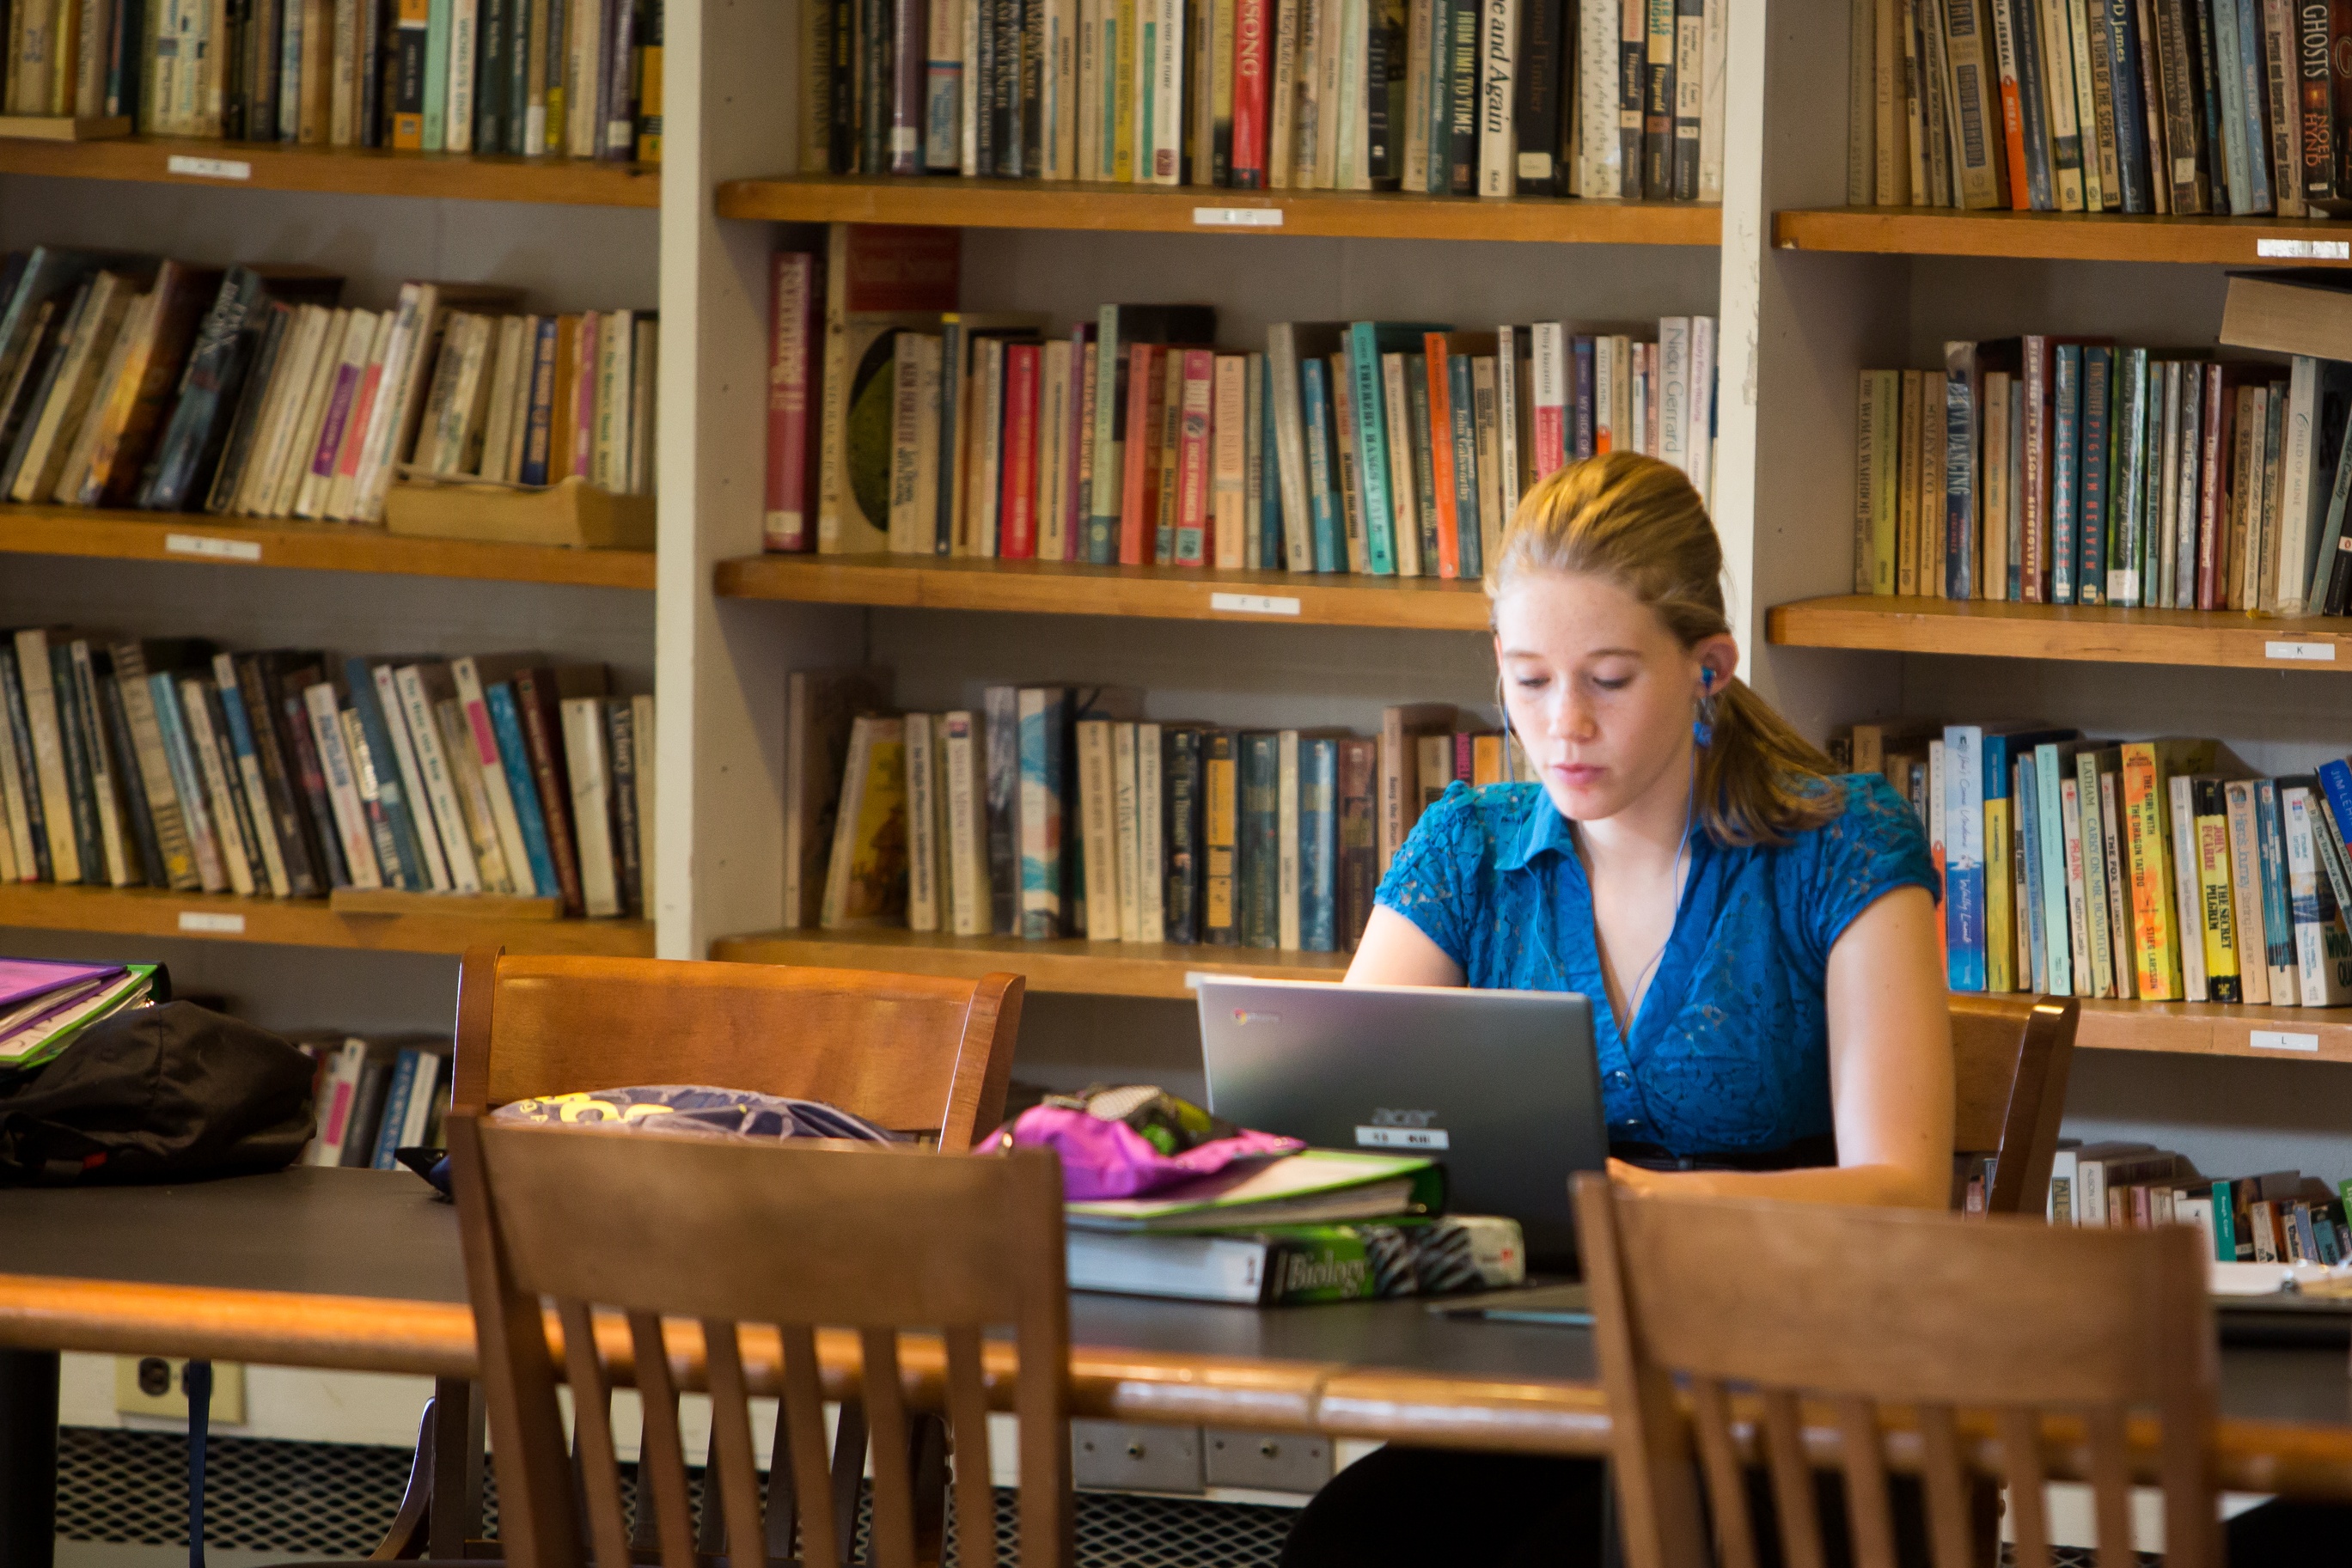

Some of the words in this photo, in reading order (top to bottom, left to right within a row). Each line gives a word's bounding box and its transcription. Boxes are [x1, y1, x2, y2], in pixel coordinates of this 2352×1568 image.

[1276, 7, 1295, 34] Hog
[1457, 10, 1476, 43] FROM
[2091, 15, 2107, 35] THE
[1491, 18, 1511, 64] and
[1998, 21, 2011, 68] JEBREAL
[2093, 39, 2110, 68] TURN
[2110, 19, 2129, 63] James
[2301, 3, 2330, 78] GHOSTS
[1280, 37, 1295, 83] Butcher
[1455, 46, 1475, 74] TIME
[1627, 53, 1640, 98] Fitzgerald
[2096, 70, 2111, 83] OF
[1455, 76, 1474, 95] TO
[1530, 51, 1549, 113] Timber
[1653, 67, 1665, 113] Fitzgerald
[2098, 86, 2111, 108] THE
[1453, 97, 1474, 135] TIME
[1486, 66, 1511, 134] Again
[1963, 111, 1986, 167] MAHFOUZ
[2099, 110, 2114, 149] SCREW
[2304, 112, 2318, 168] HYND
[2316, 113, 2331, 165] NOEL
[1665, 327, 1685, 375] Nicci
[2028, 342, 2039, 374] HIGH
[1863, 377, 1873, 399] THE
[2028, 378, 2039, 408] TIDE
[2058, 359, 2076, 416] KINGSOLVER
[2087, 361, 2105, 418] KINGSOLVER
[2123, 355, 2135, 398] Barbara
[1579, 394, 1589, 411] MY
[1664, 380, 1683, 454] Gerrard
[1456, 408, 1469, 436] John
[1579, 412, 1589, 437] SIDE
[1859, 401, 1872, 452] WOMAN
[2027, 412, 2038, 428] IN
[2120, 400, 2134, 458] Kingsolver
[2294, 412, 2310, 460] CHILD
[1187, 442, 1200, 471] DICK
[1579, 439, 1589, 452] OF
[2026, 432, 2038, 482] TUCSON
[2059, 418, 2073, 462] PIGS
[2087, 419, 2100, 463] PIGS
[1456, 437, 1469, 503] Galsworthy
[1946, 432, 1972, 497] DANCING
[2058, 470, 2073, 490] IN
[2294, 461, 2303, 475] OF
[1184, 473, 1198, 523] FRANCIS
[1857, 454, 1871, 516] WARRIOR
[2086, 472, 2099, 492] IN
[2292, 478, 2302, 507] MINE
[2025, 495, 2037, 577] KINGSOLVER
[2057, 498, 2073, 570] HEAVEN
[2085, 500, 2098, 570] HEAVEN
[2296, 645, 2305, 656] K
[612, 706, 632, 774] Victory
[622, 824, 637, 869] Conrad
[1387, 776, 1398, 800] Bang
[2082, 760, 2096, 808] LATHAM
[2142, 773, 2154, 790] THE
[2330, 768, 2345, 790] JIM
[1389, 802, 1399, 819] the
[2129, 803, 2141, 820] THE
[2143, 792, 2155, 814] GIRL
[1389, 821, 1400, 847] Drum
[2086, 817, 2098, 855] CARRY
[2131, 821, 2143, 857] DRAGON
[2145, 814, 2157, 836] WITH
[2213, 824, 2226, 854] JOHN
[2068, 838, 2082, 882] PRANK
[2106, 833, 2117, 857] THE
[2109, 859, 2119, 883] FOX
[2134, 857, 2146, 888] TATTOO
[1957, 878, 1972, 911] Wally
[2205, 884, 2220, 931] PILGRIM
[2217, 884, 2230, 906] THE
[1958, 912, 1972, 943] Lamb
[2074, 896, 2086, 930] Kathryn
[2218, 906, 2233, 950] SECRET
[2075, 931, 2087, 958] Lasky
[2093, 901, 2108, 963] BOWDITCH
[2145, 925, 2157, 951] STIEG
[2147, 951, 2159, 991] LARSSON
[2281, 1036, 2288, 1046] L
[1371, 1107, 1438, 1127] acer
[2086, 1168, 2096, 1197] ALISON
[1291, 1250, 1367, 1296] Biology
